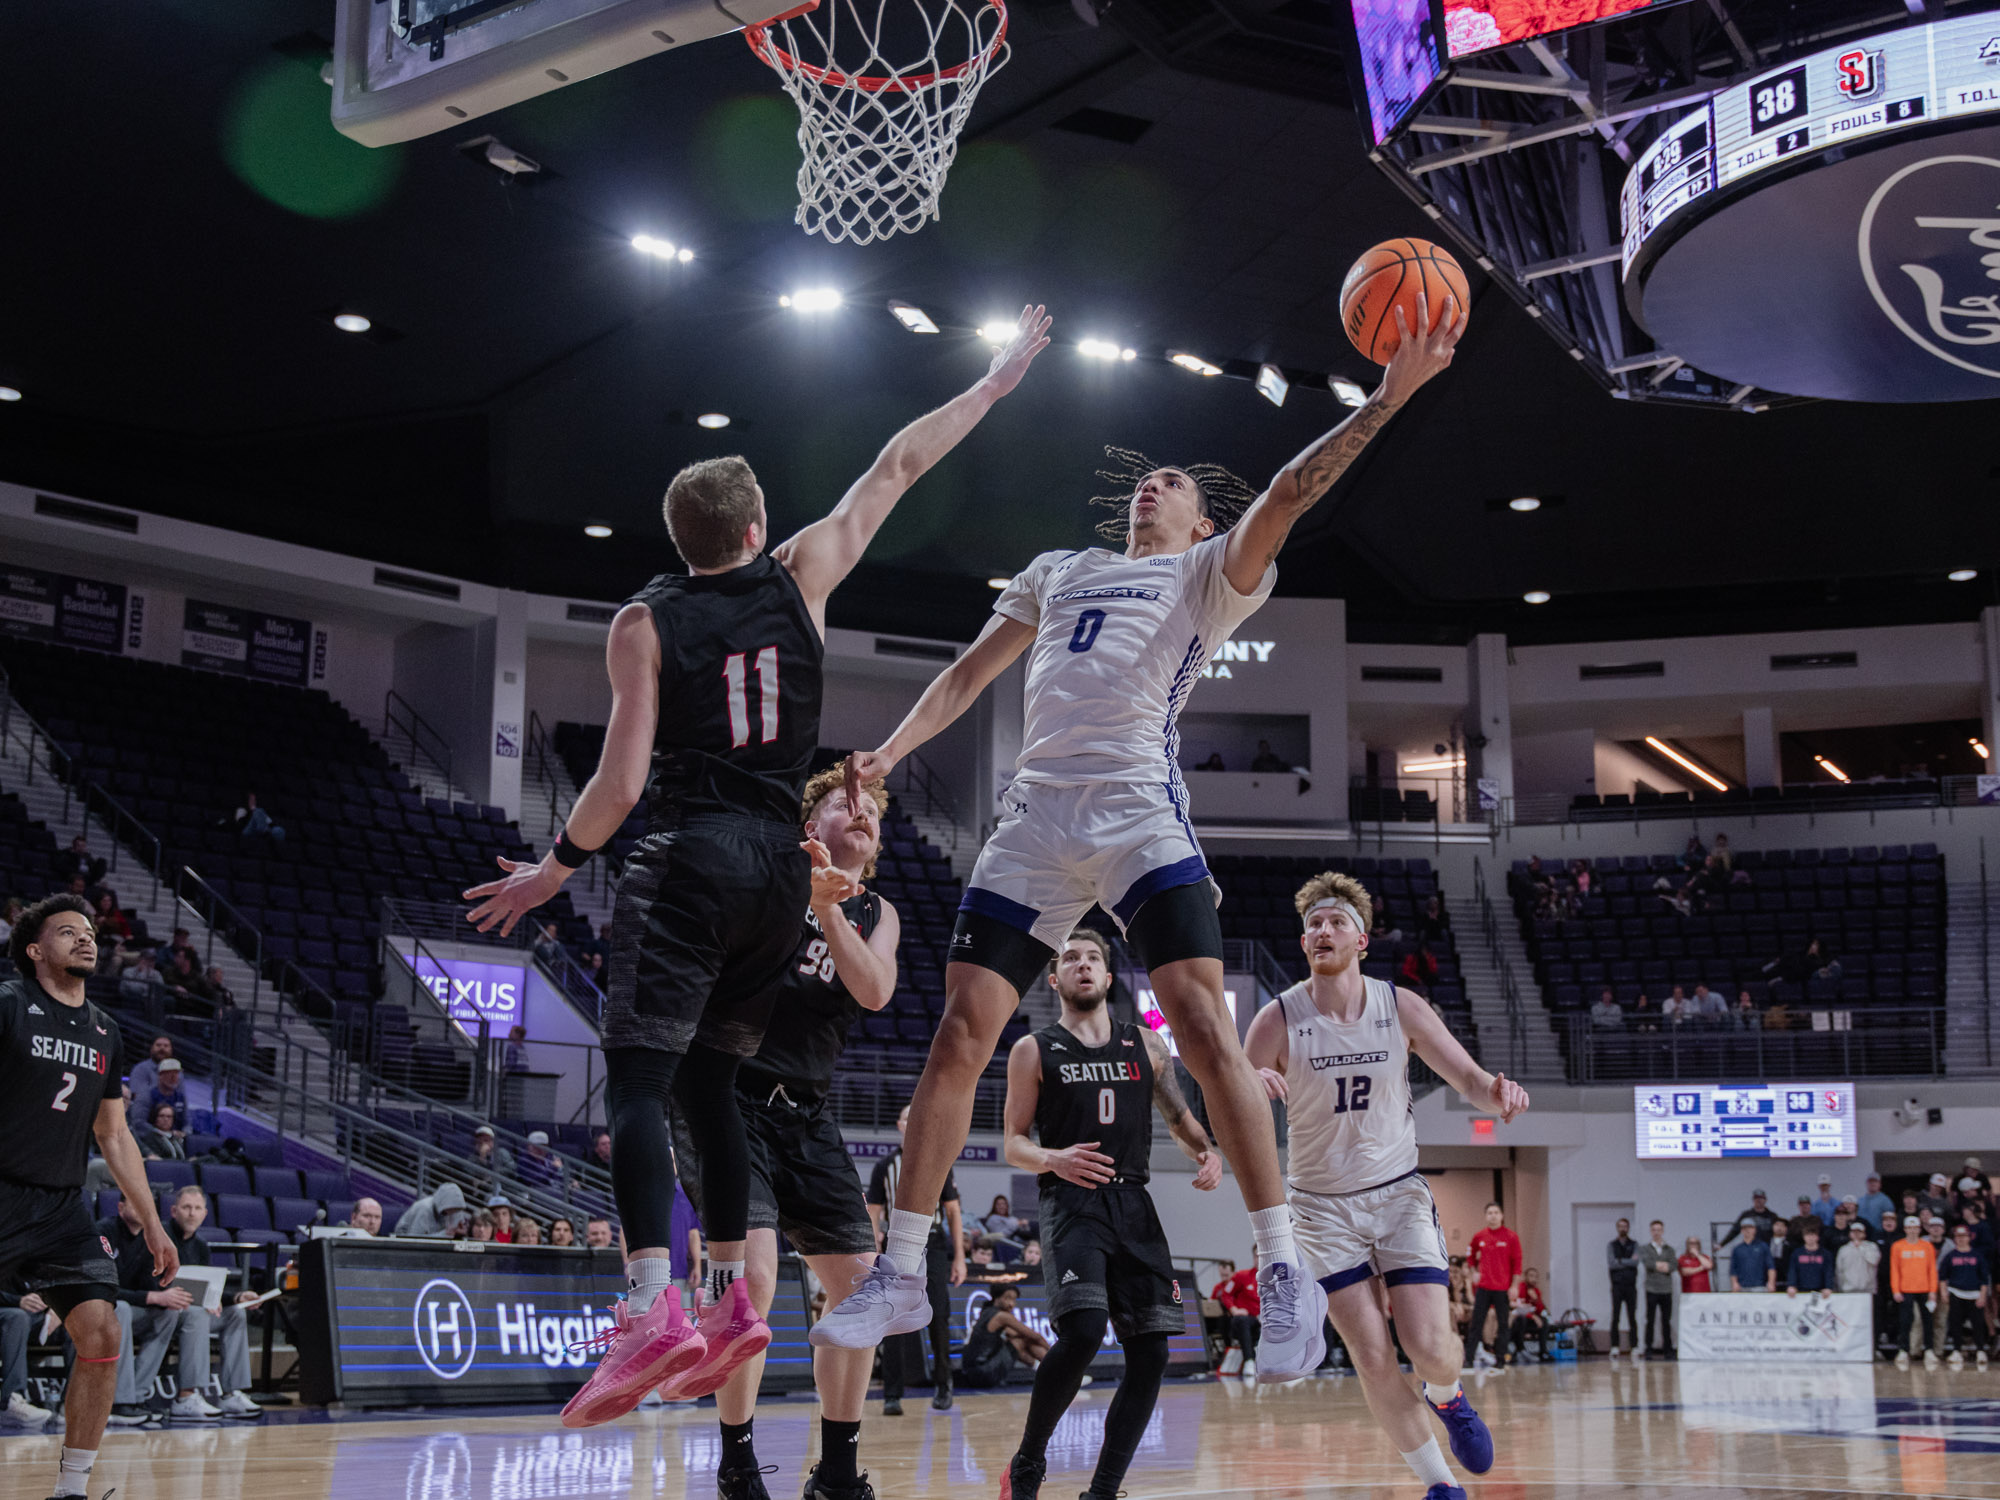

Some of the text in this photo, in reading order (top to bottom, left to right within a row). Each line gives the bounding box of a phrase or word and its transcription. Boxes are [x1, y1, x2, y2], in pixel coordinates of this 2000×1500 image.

[1756, 79, 1796, 122] 38
[1831, 101, 1912, 134] FOULS 8
[1652, 139, 1682, 180] 8:29
[1736, 133, 1798, 169] T.O.L. 2
[1047, 587, 1161, 607] WILDCATS
[1068, 609, 1107, 653] 0
[721, 645, 780, 750] 11
[500, 724, 518, 735] 104
[31, 1034, 106, 1075] SEATTLEU
[1059, 1061, 1141, 1084] SEATTLEU
[1309, 1050, 1389, 1071] WILDCATS
[51, 1072, 78, 1112] 2
[1098, 1087, 1116, 1125] 0
[1334, 1075, 1372, 1114] 12
[1676, 1095, 1695, 1112] 57
[1788, 1093, 1810, 1110] 38
[1699, 1311, 1792, 1324] ANTHONY
